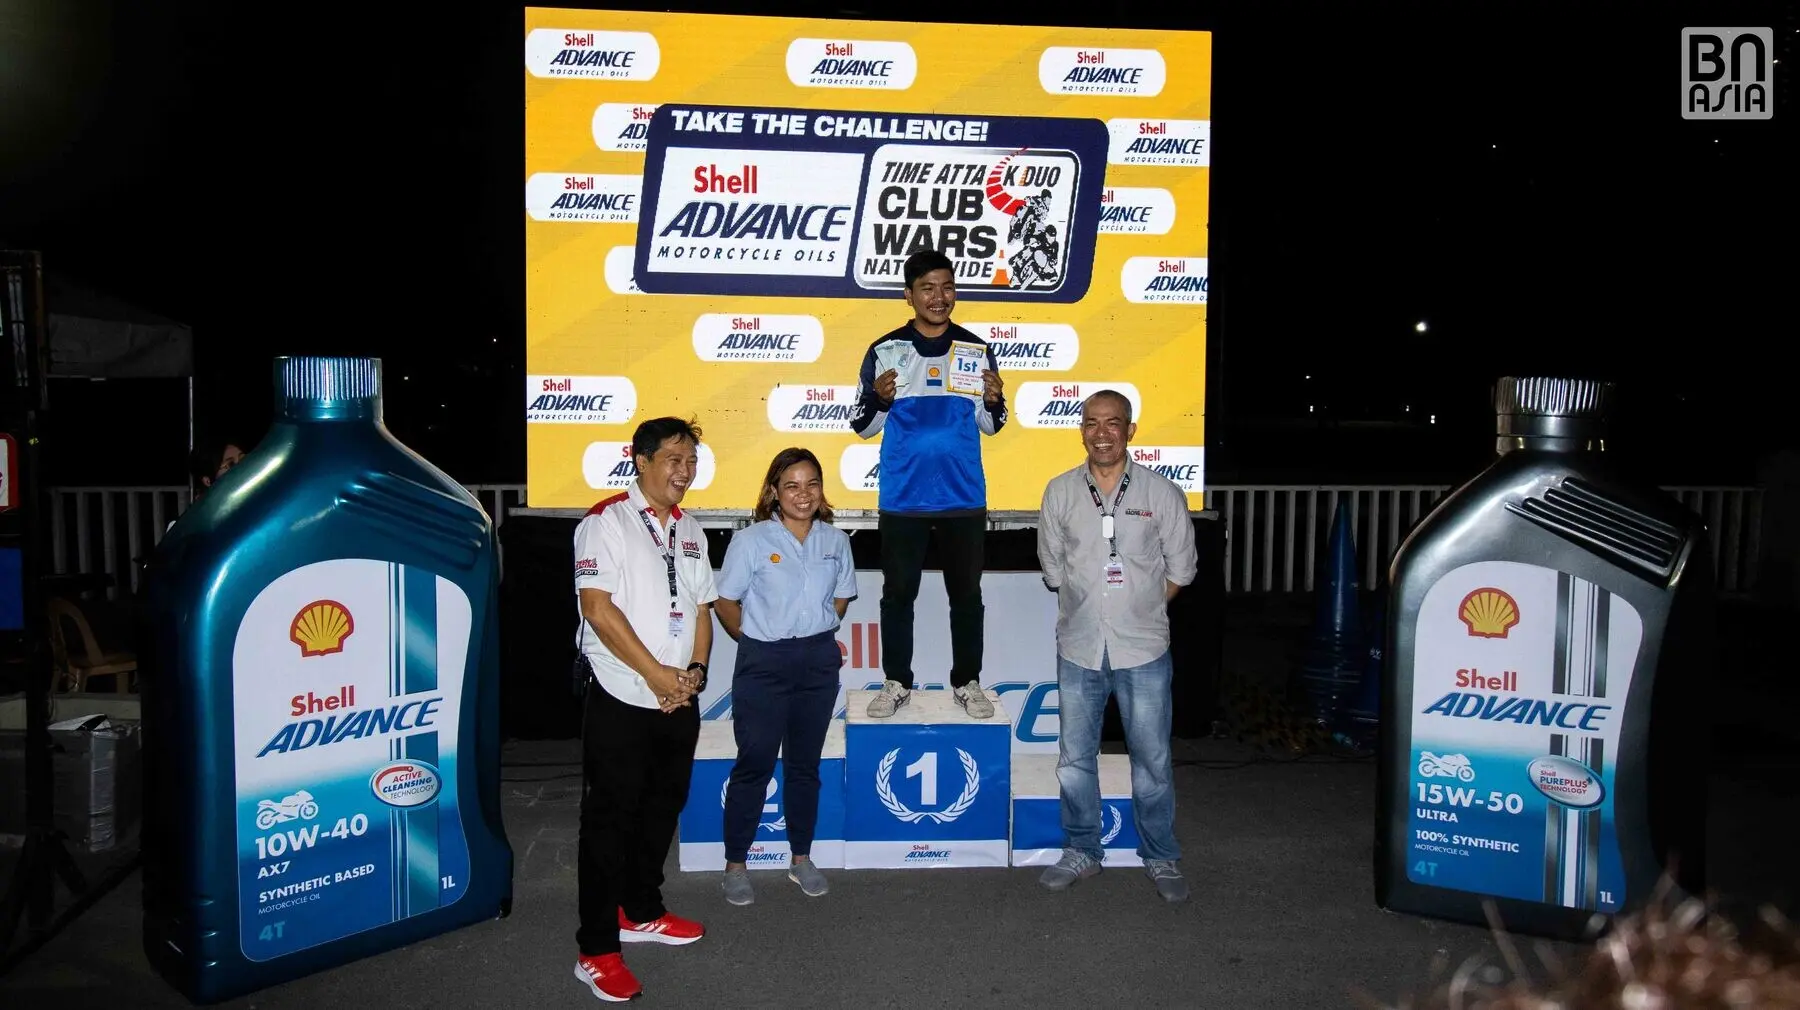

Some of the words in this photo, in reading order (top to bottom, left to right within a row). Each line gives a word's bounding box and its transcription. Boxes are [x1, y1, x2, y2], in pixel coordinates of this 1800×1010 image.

[565, 33, 594, 46] Shell
[825, 43, 853, 56] Shell
[1077, 51, 1104, 64] Shell
[550, 49, 635, 67] ADVANCE
[811, 59, 894, 77] ADVANCE
[1063, 67, 1144, 84] ADVANCE
[671, 110, 744, 133] TAKE
[752, 112, 807, 136] THE
[814, 115, 989, 141] CHALLENGE!
[1139, 122, 1166, 134] Shell
[1125, 138, 1205, 155] ADVANCE
[694, 164, 757, 194] Shell
[881, 161, 933, 184] TIME
[1023, 166, 1061, 187] DUO
[565, 177, 594, 190] Shell
[550, 193, 635, 211] ADVANCE
[878, 185, 985, 221] CLUB
[659, 201, 851, 241] ADVANCE
[1099, 205, 1153, 222] VANCE
[873, 223, 998, 259] WARS
[657, 246, 782, 260] MOTORCYCLE
[795, 250, 835, 261] OILS
[1159, 260, 1185, 273] Shell
[732, 318, 760, 330] Shell
[990, 326, 1017, 339] Shell
[718, 333, 801, 350] ADVANCE
[988, 342, 1056, 358] DVANCE
[957, 358, 978, 373] 1st
[543, 379, 571, 392] Shell
[1052, 385, 1079, 398] Shell
[806, 388, 834, 401] Shell
[528, 395, 613, 411] ADVANCE
[792, 404, 852, 420] ADVAN
[1134, 449, 1160, 461] Shell
[1455, 668, 1517, 691] Shell
[291, 685, 355, 717] Shell
[1421, 692, 1612, 731] ADVANCE
[255, 697, 443, 758] ADVANCE
[383, 776, 432, 793] CLEANSING
[393, 771, 423, 783] ACTIVE
[906, 752, 938, 805] 1
[391, 784, 435, 799] TECHNOLOGY
[1540, 784, 1588, 794] TECHNOLOGY
[1416, 782, 1524, 815] 15W-50
[1416, 808, 1459, 823] ULTRA
[255, 813, 369, 861] 10W-40
[1415, 829, 1449, 843] 100%
[1452, 834, 1520, 853] SYNTHETIC
[905, 850, 951, 859] ADVANCE
[1414, 843, 1458, 856] MOTORCYCLE
[1458, 849, 1470, 857] OIL
[257, 860, 290, 879] AX7
[1414, 860, 1438, 876] 4T
[259, 876, 331, 903] SYNTHETIC
[334, 863, 375, 884] BASED
[441, 876, 456, 890] 1L
[258, 895, 308, 915] MOTORCYCLE
[309, 892, 321, 902] OIL
[1599, 891, 1614, 904] 1L
[258, 920, 285, 942] 4T
